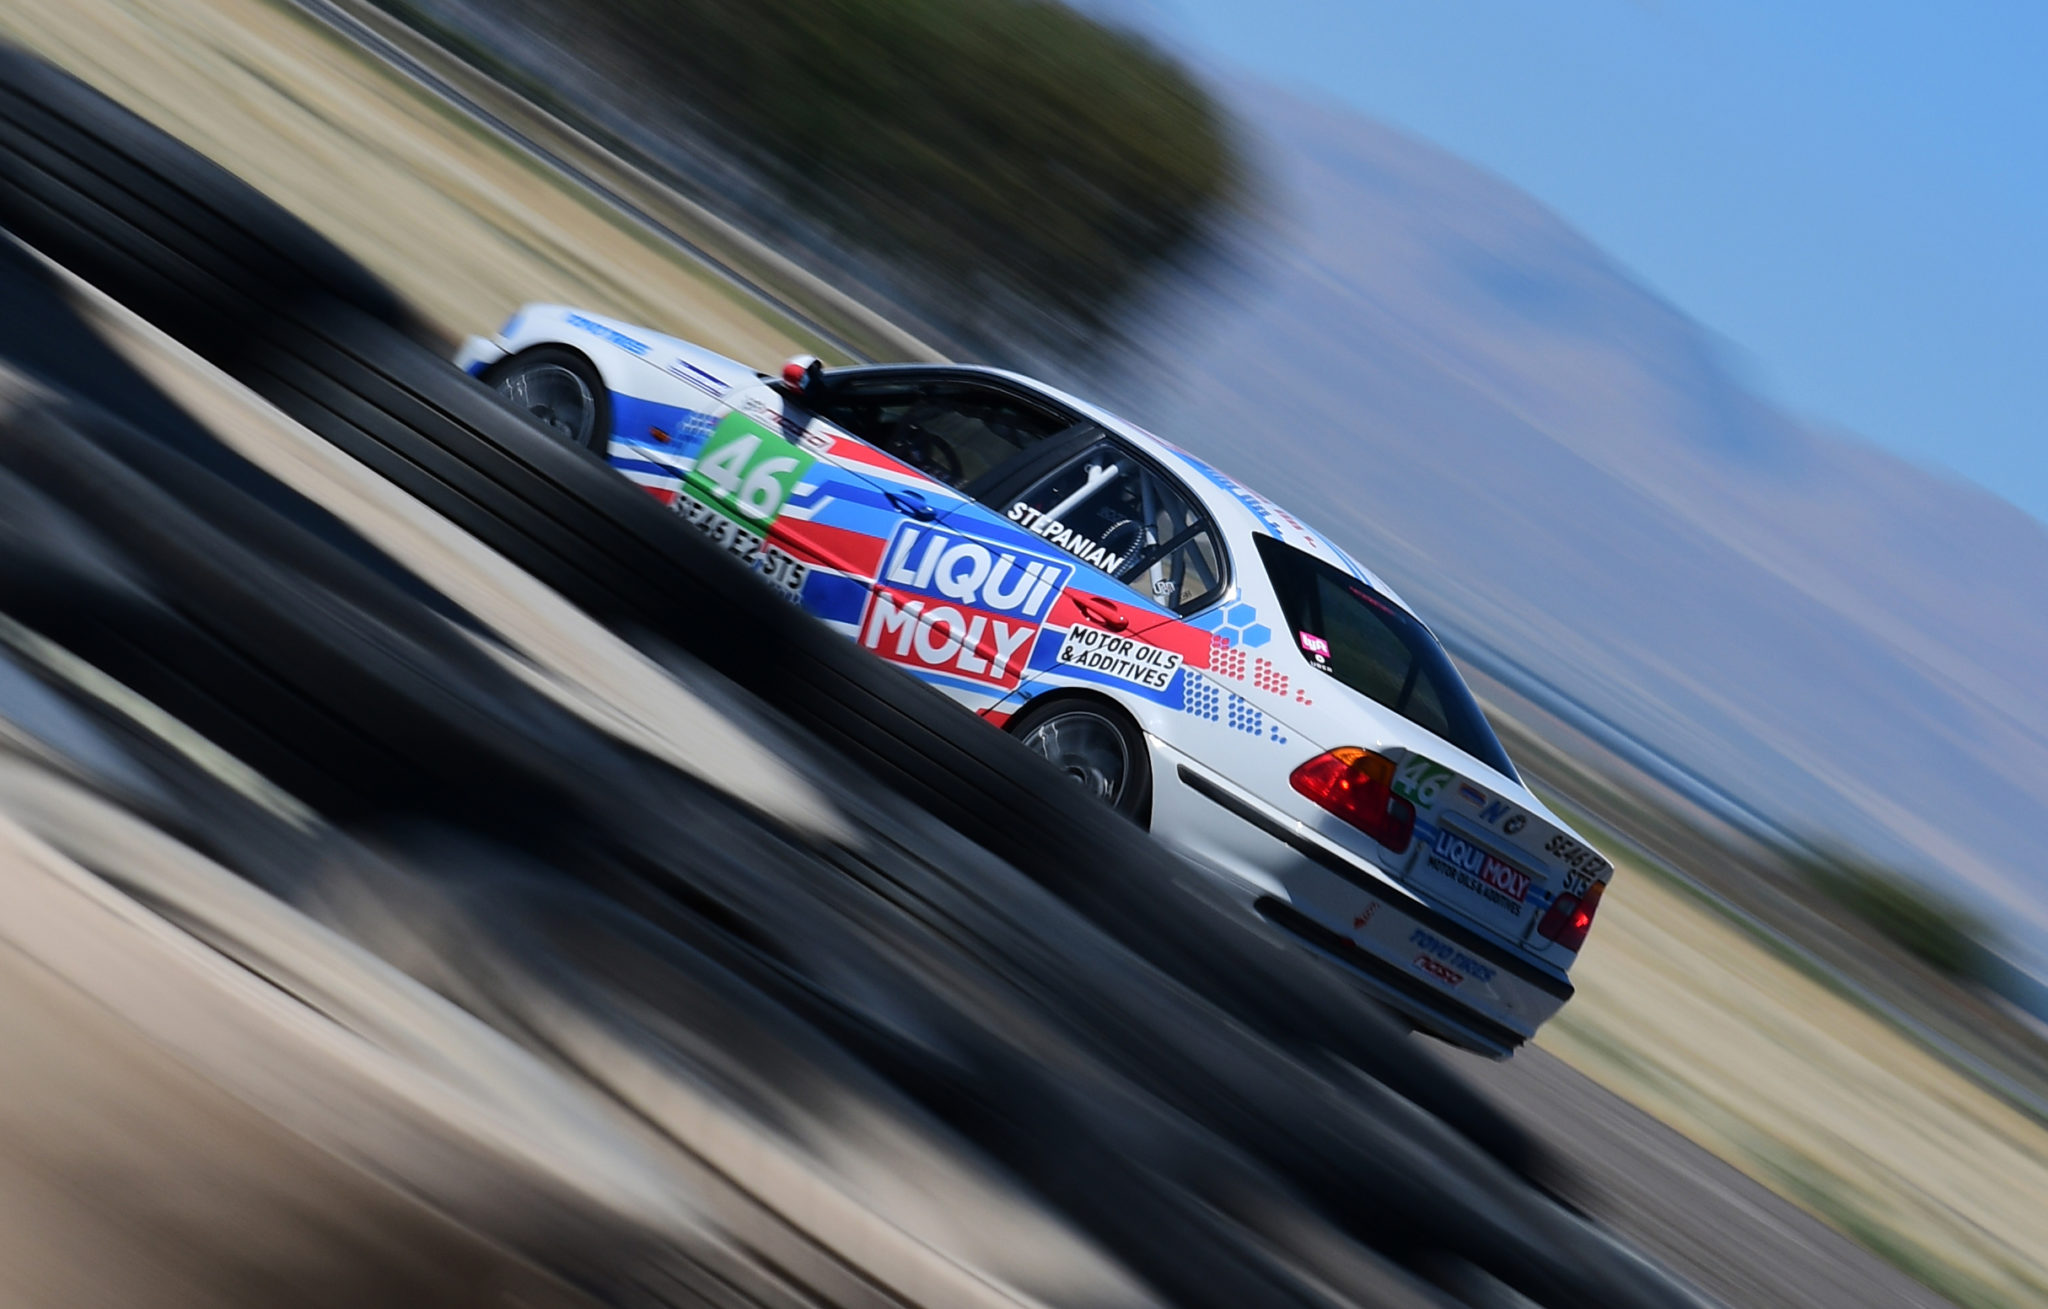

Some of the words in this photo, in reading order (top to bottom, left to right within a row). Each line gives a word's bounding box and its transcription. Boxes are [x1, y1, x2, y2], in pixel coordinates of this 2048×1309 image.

[696, 431, 800, 519] 46
[728, 528, 780, 564] E2
[1007, 501, 1125, 574] STEPANIAN
[886, 527, 1062, 617] LIQUI
[864, 591, 1036, 680] MOLY
[1069, 625, 1134, 657] MOTOR
[1135, 645, 1179, 670] OILS
[1061, 645, 1074, 662] &
[1077, 651, 1169, 688] ADDITIVES
[1393, 762, 1451, 808] 46
[1436, 831, 1485, 876] LIQUI
[1482, 857, 1531, 898] MOLY
[1545, 835, 1590, 867] SE46
[1580, 856, 1607, 878] E2
